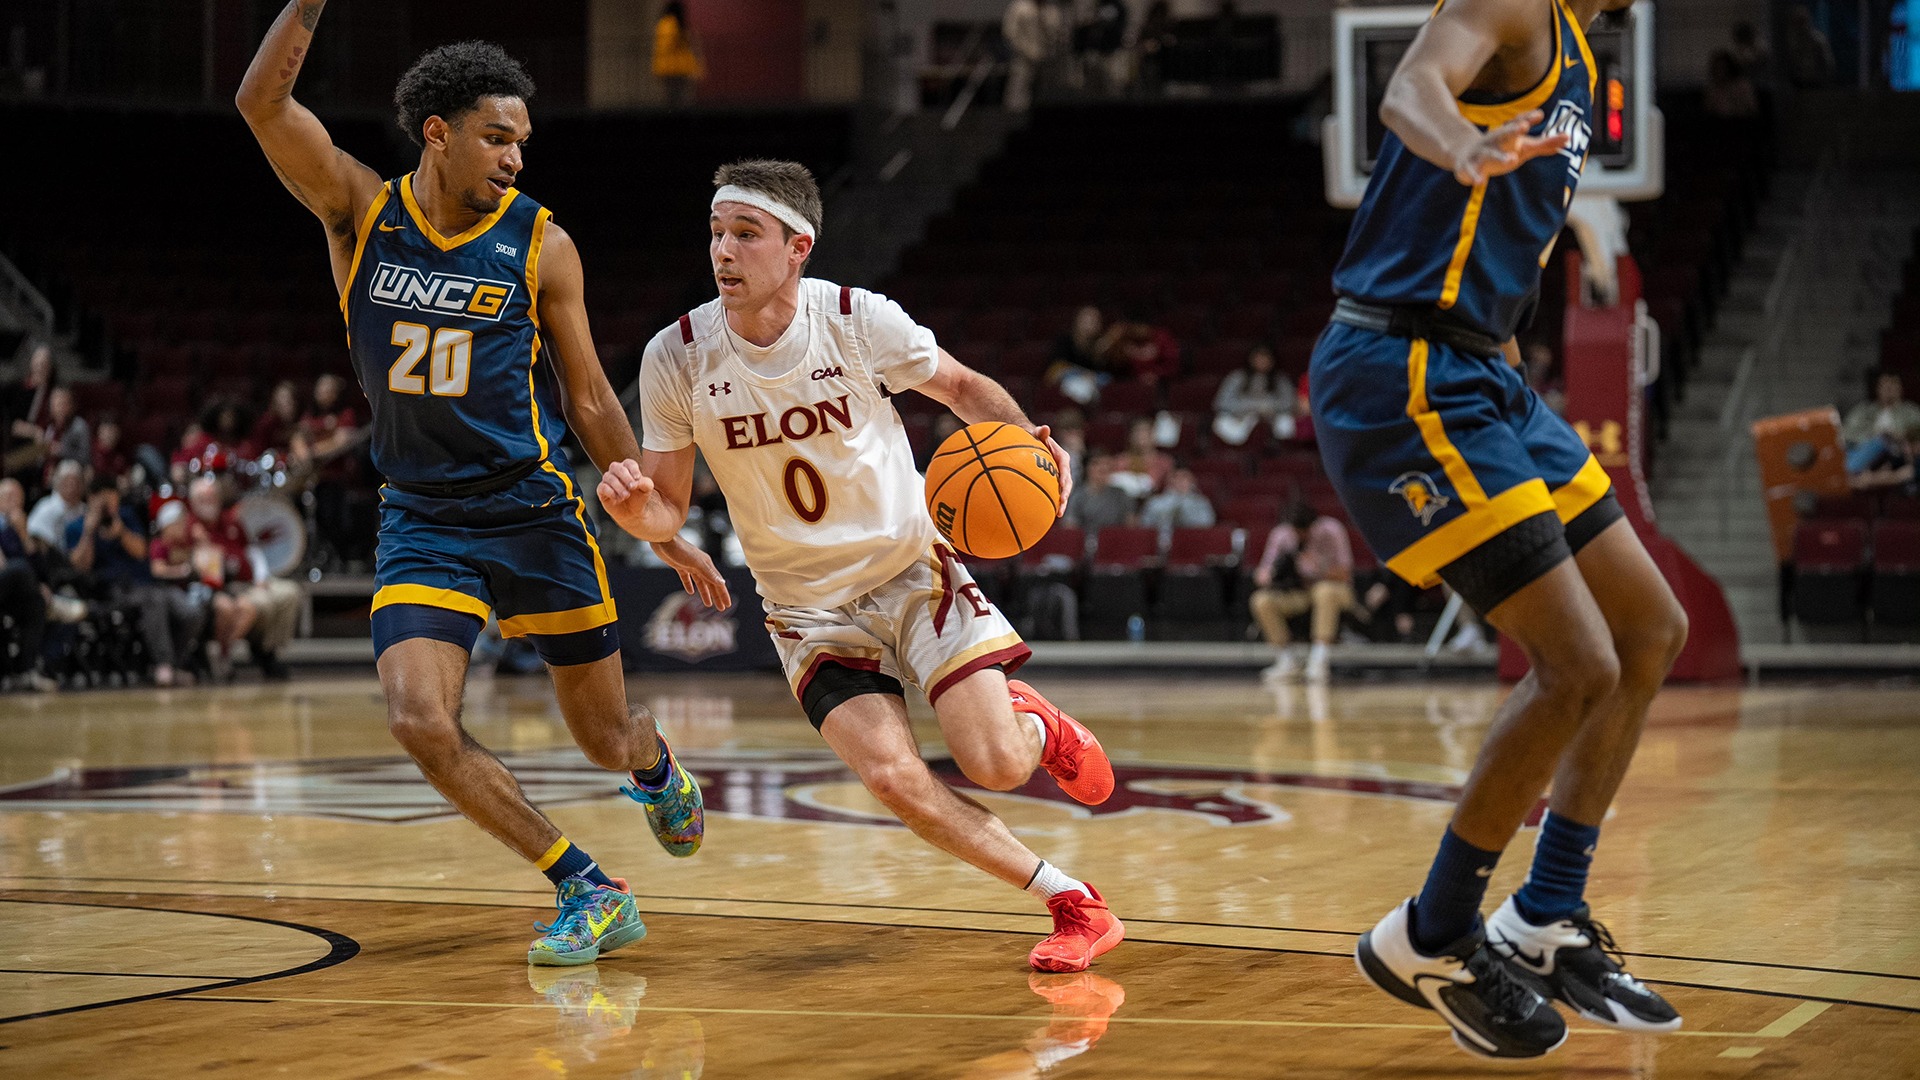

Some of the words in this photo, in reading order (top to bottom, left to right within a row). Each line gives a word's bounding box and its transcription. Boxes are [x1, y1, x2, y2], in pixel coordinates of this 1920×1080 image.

[369, 265, 513, 319] UNCG
[388, 321, 473, 397] 20
[811, 366, 844, 381] CAA
[719, 394, 853, 450] ELON
[782, 456, 829, 525] 0
[957, 583, 992, 618] E
